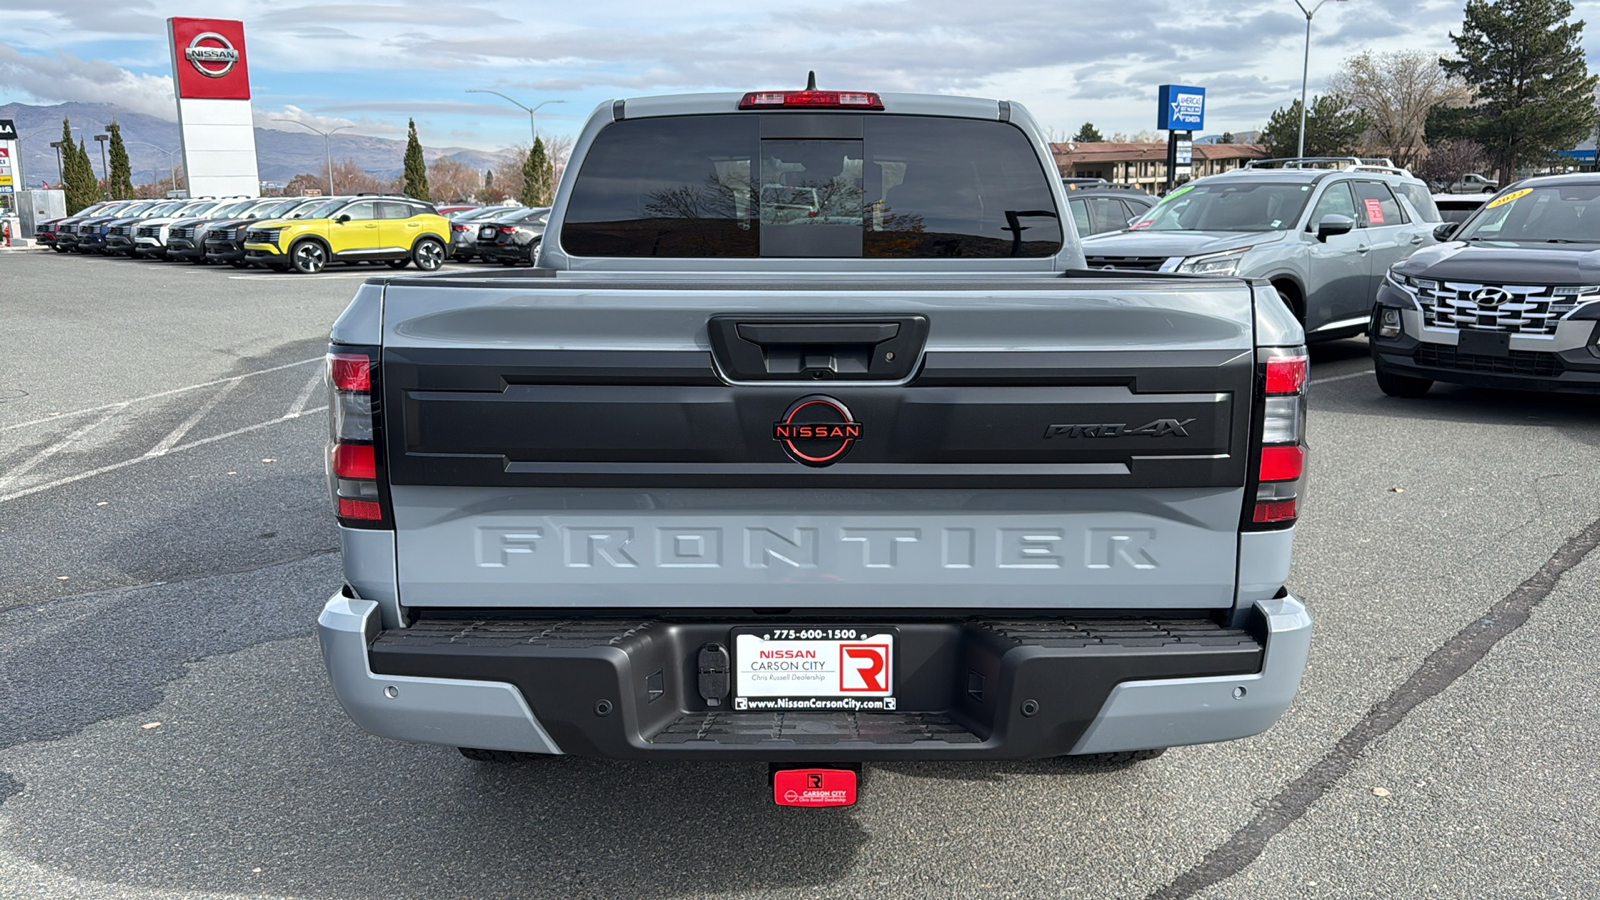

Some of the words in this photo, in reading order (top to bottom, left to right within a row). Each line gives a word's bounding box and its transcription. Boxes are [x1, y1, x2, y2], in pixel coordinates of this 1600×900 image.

[191, 50, 235, 58] NISSAN
[776, 426, 859, 437] NISSAN
[1044, 418, 1196, 439] PRO-4X
[474, 525, 1160, 569] FRONTIER
[773, 629, 857, 640] 775-600-1500
[759, 650, 816, 659] NISSAN
[750, 661, 799, 671] CARSON
[802, 661, 826, 671] CITY
[791, 674, 826, 682] Dealership
[748, 698, 883, 711] www.NissanCarsonCity.com
